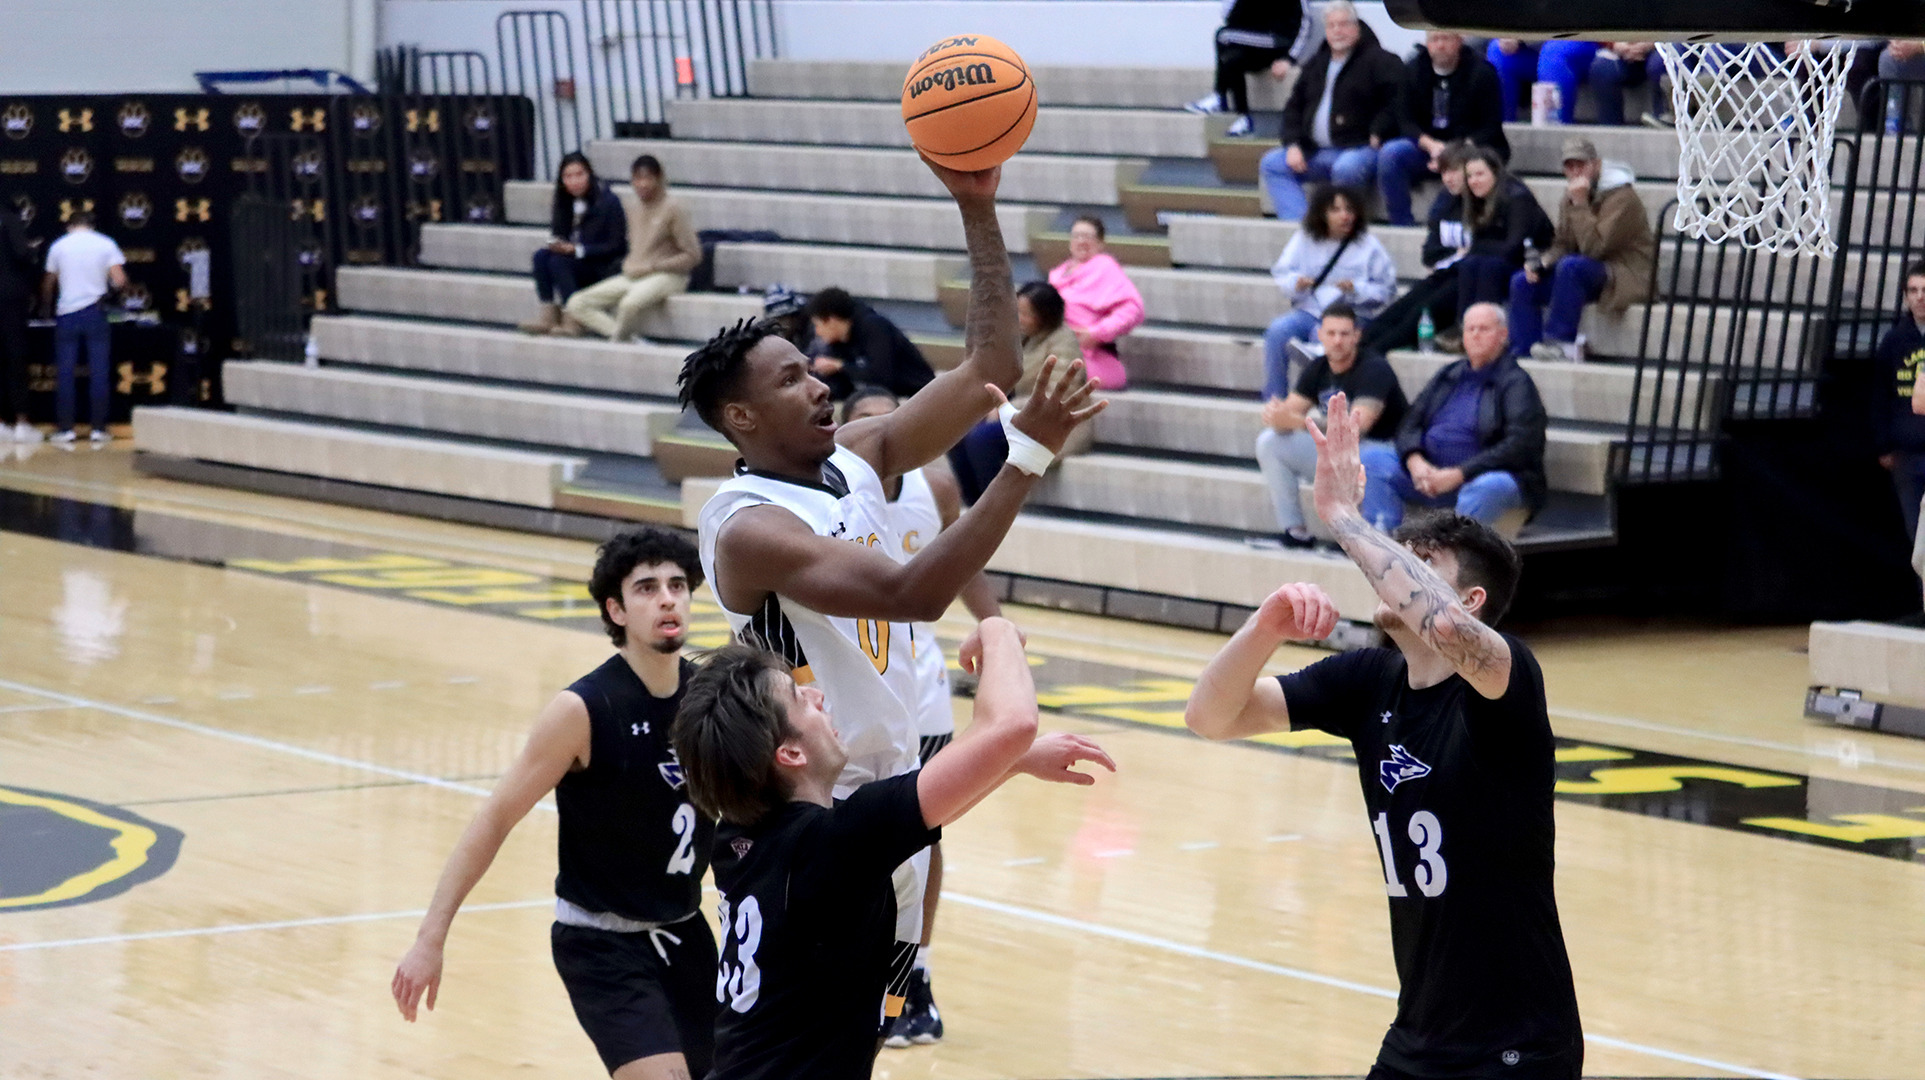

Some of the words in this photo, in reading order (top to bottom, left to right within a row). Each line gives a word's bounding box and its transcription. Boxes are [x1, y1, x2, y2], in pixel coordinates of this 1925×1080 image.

[908, 62, 996, 99] Wilson
[665, 802, 696, 875] 2
[1372, 810, 1448, 898] 13
